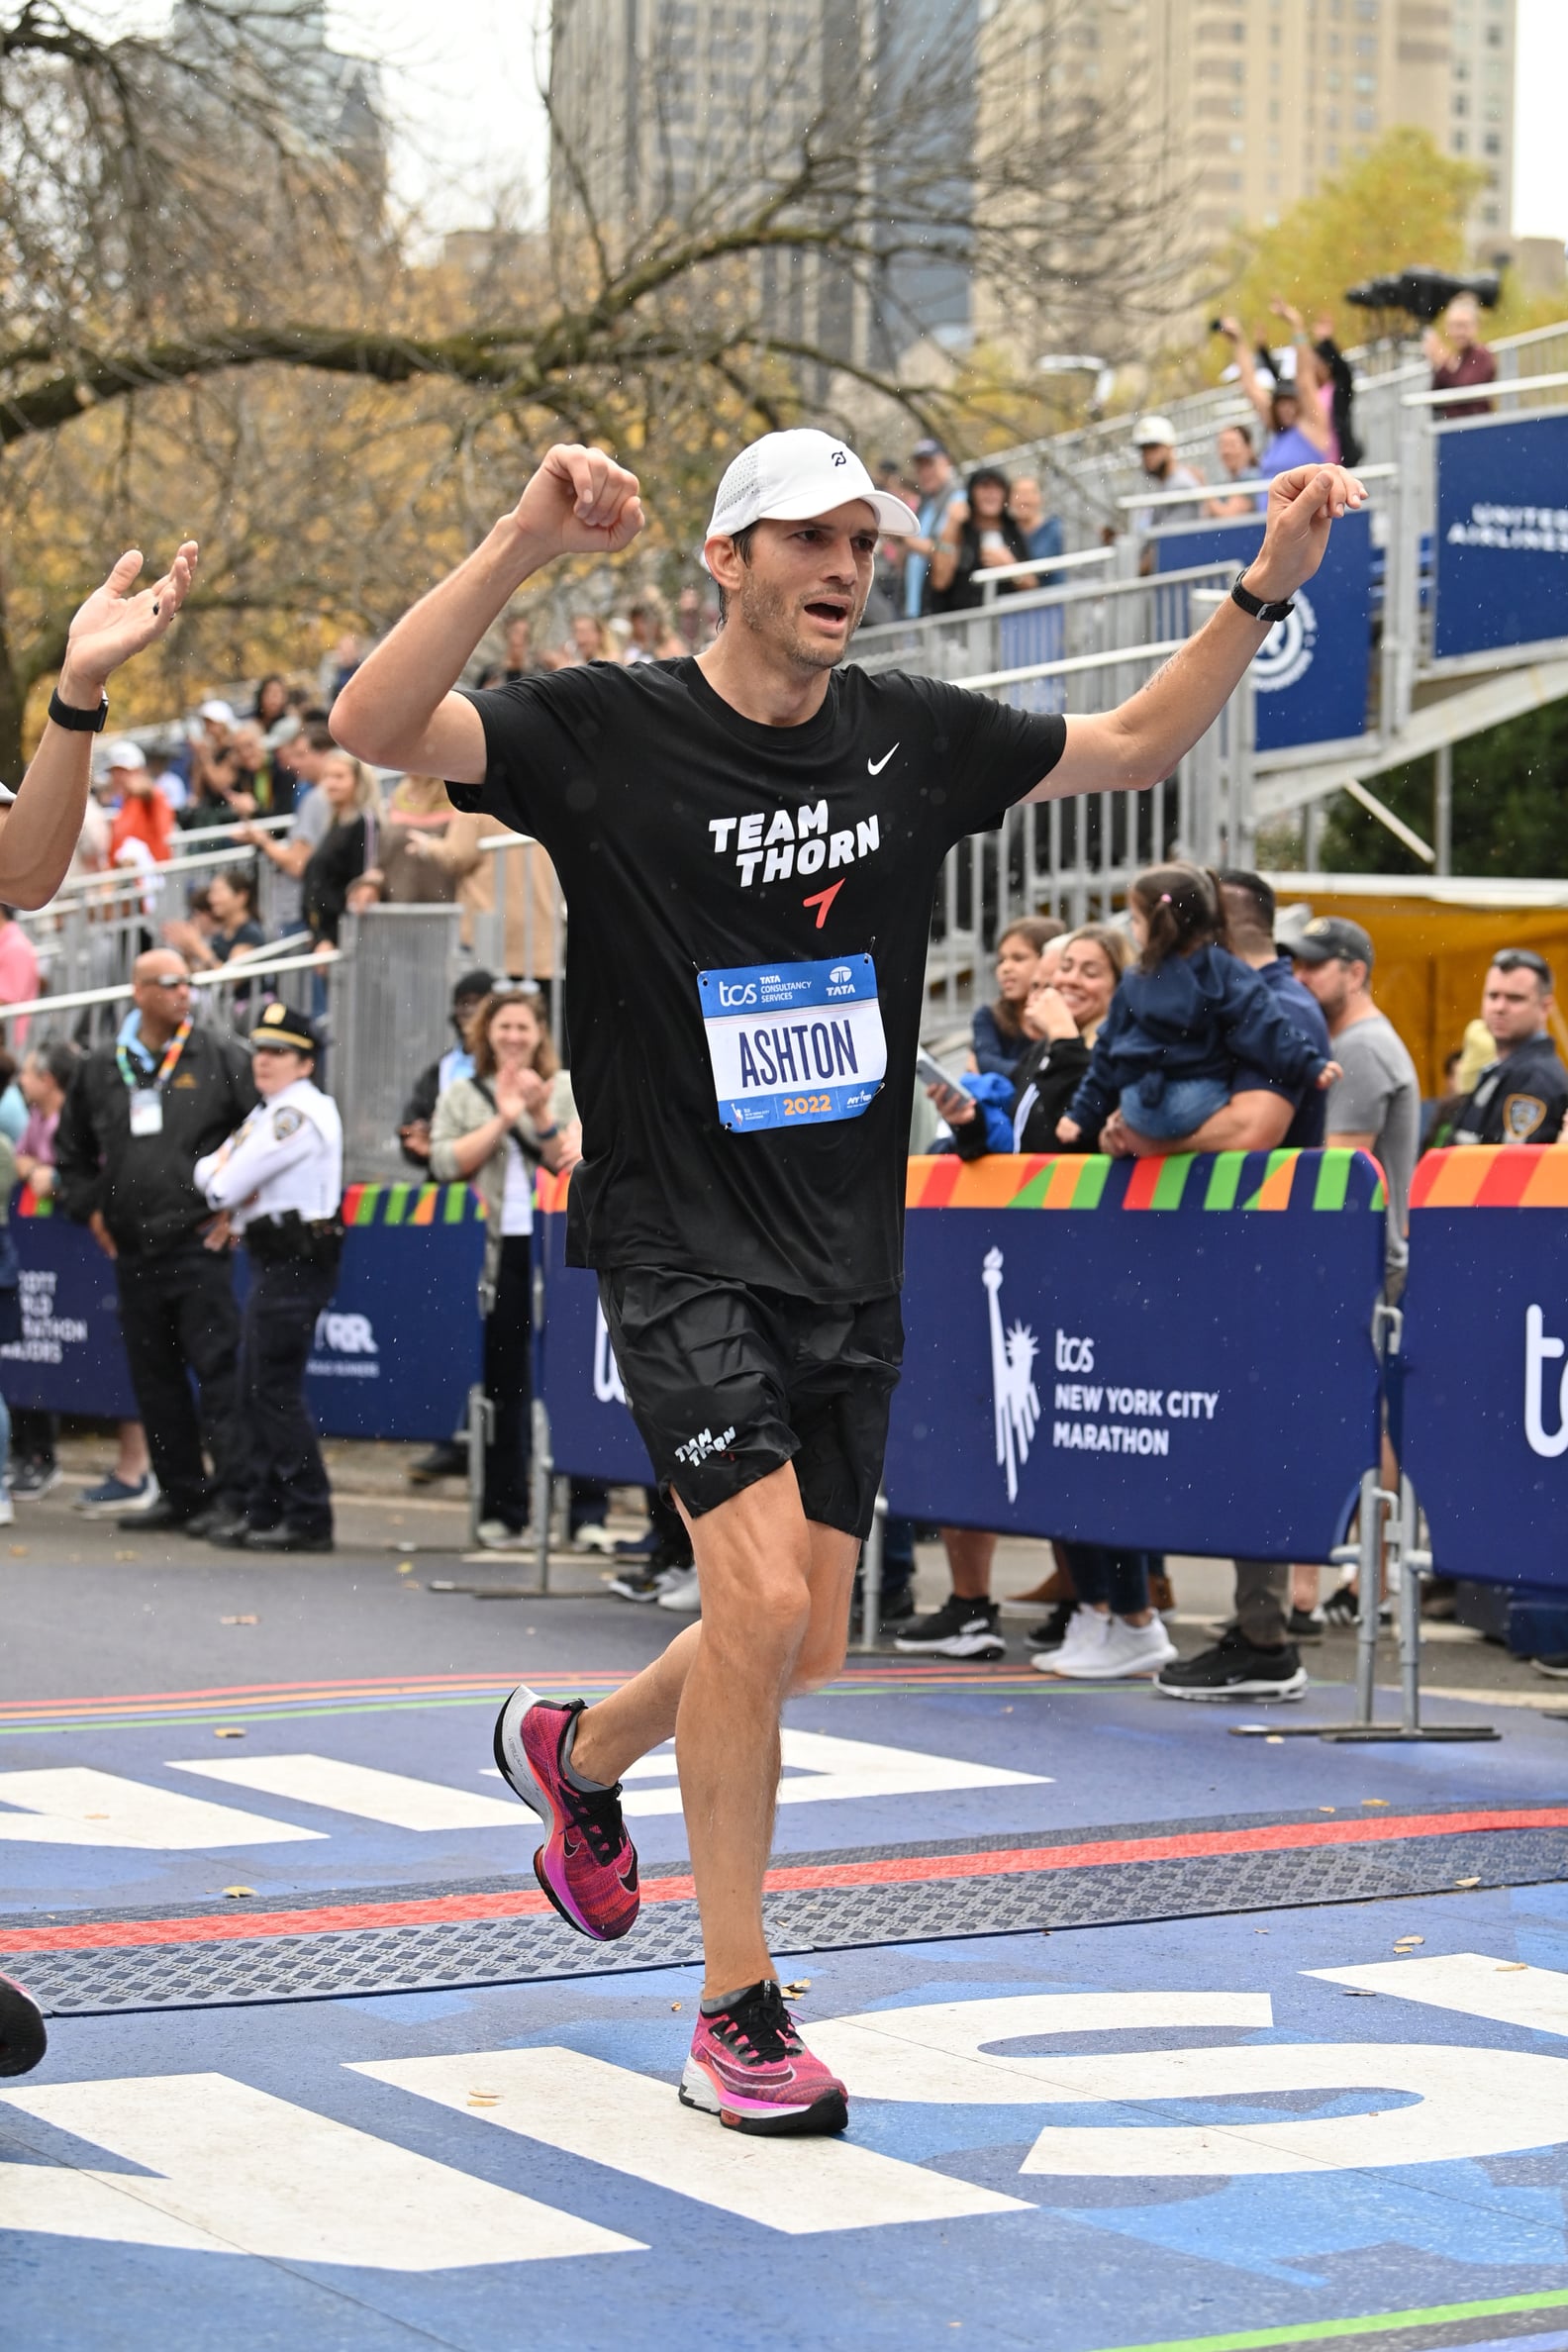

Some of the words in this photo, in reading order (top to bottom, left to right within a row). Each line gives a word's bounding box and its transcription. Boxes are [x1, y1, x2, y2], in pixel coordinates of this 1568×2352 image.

[708, 799, 829, 853] TEAM
[735, 815, 880, 887] THORN
[719, 980, 757, 1007] tcs
[759, 975, 781, 985] TATA
[760, 981, 812, 994] CONSULTANCY
[826, 984, 856, 997] TATA
[760, 992, 793, 1003] SERVICES
[738, 1020, 859, 1088] ASHTON
[783, 1095, 833, 1116] 2022
[1055, 1328, 1095, 1373] tcs
[1054, 1383, 1104, 1414] NEW
[1106, 1386, 1164, 1417] YORK
[1166, 1390, 1220, 1420] CITY
[1052, 1421, 1170, 1457] MARATHON
